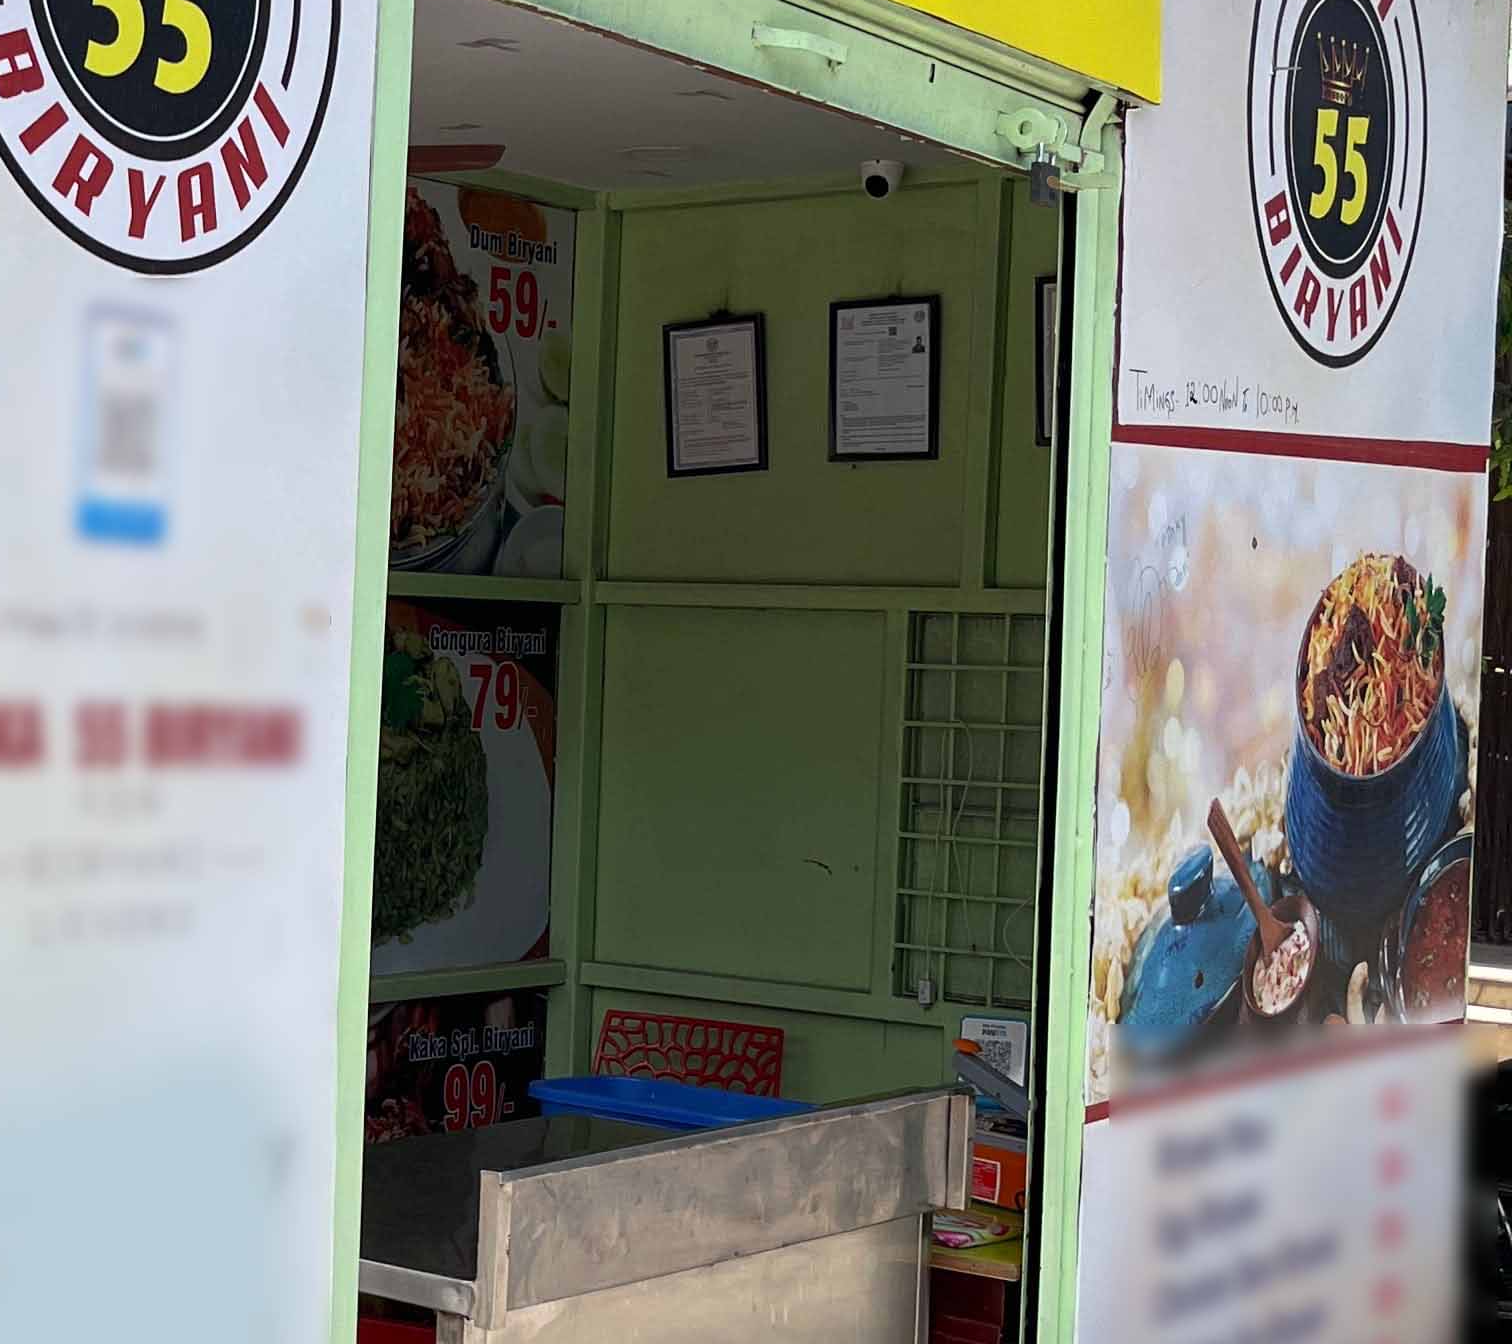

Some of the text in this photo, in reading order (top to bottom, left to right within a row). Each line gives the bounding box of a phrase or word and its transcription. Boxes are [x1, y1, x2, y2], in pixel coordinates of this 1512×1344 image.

[1308, 108, 1371, 227] 55
[469, 223, 559, 266] Dum Biryani
[1264, 189, 1404, 342] BIRYANI
[488, 266, 558, 341] 59/-
[429, 624, 548, 658] Gongura Biryani
[470, 660, 538, 732] 79/-
[408, 1021, 536, 1062] Kaka Spl. Biryani
[443, 1060, 516, 1133] 99/-
